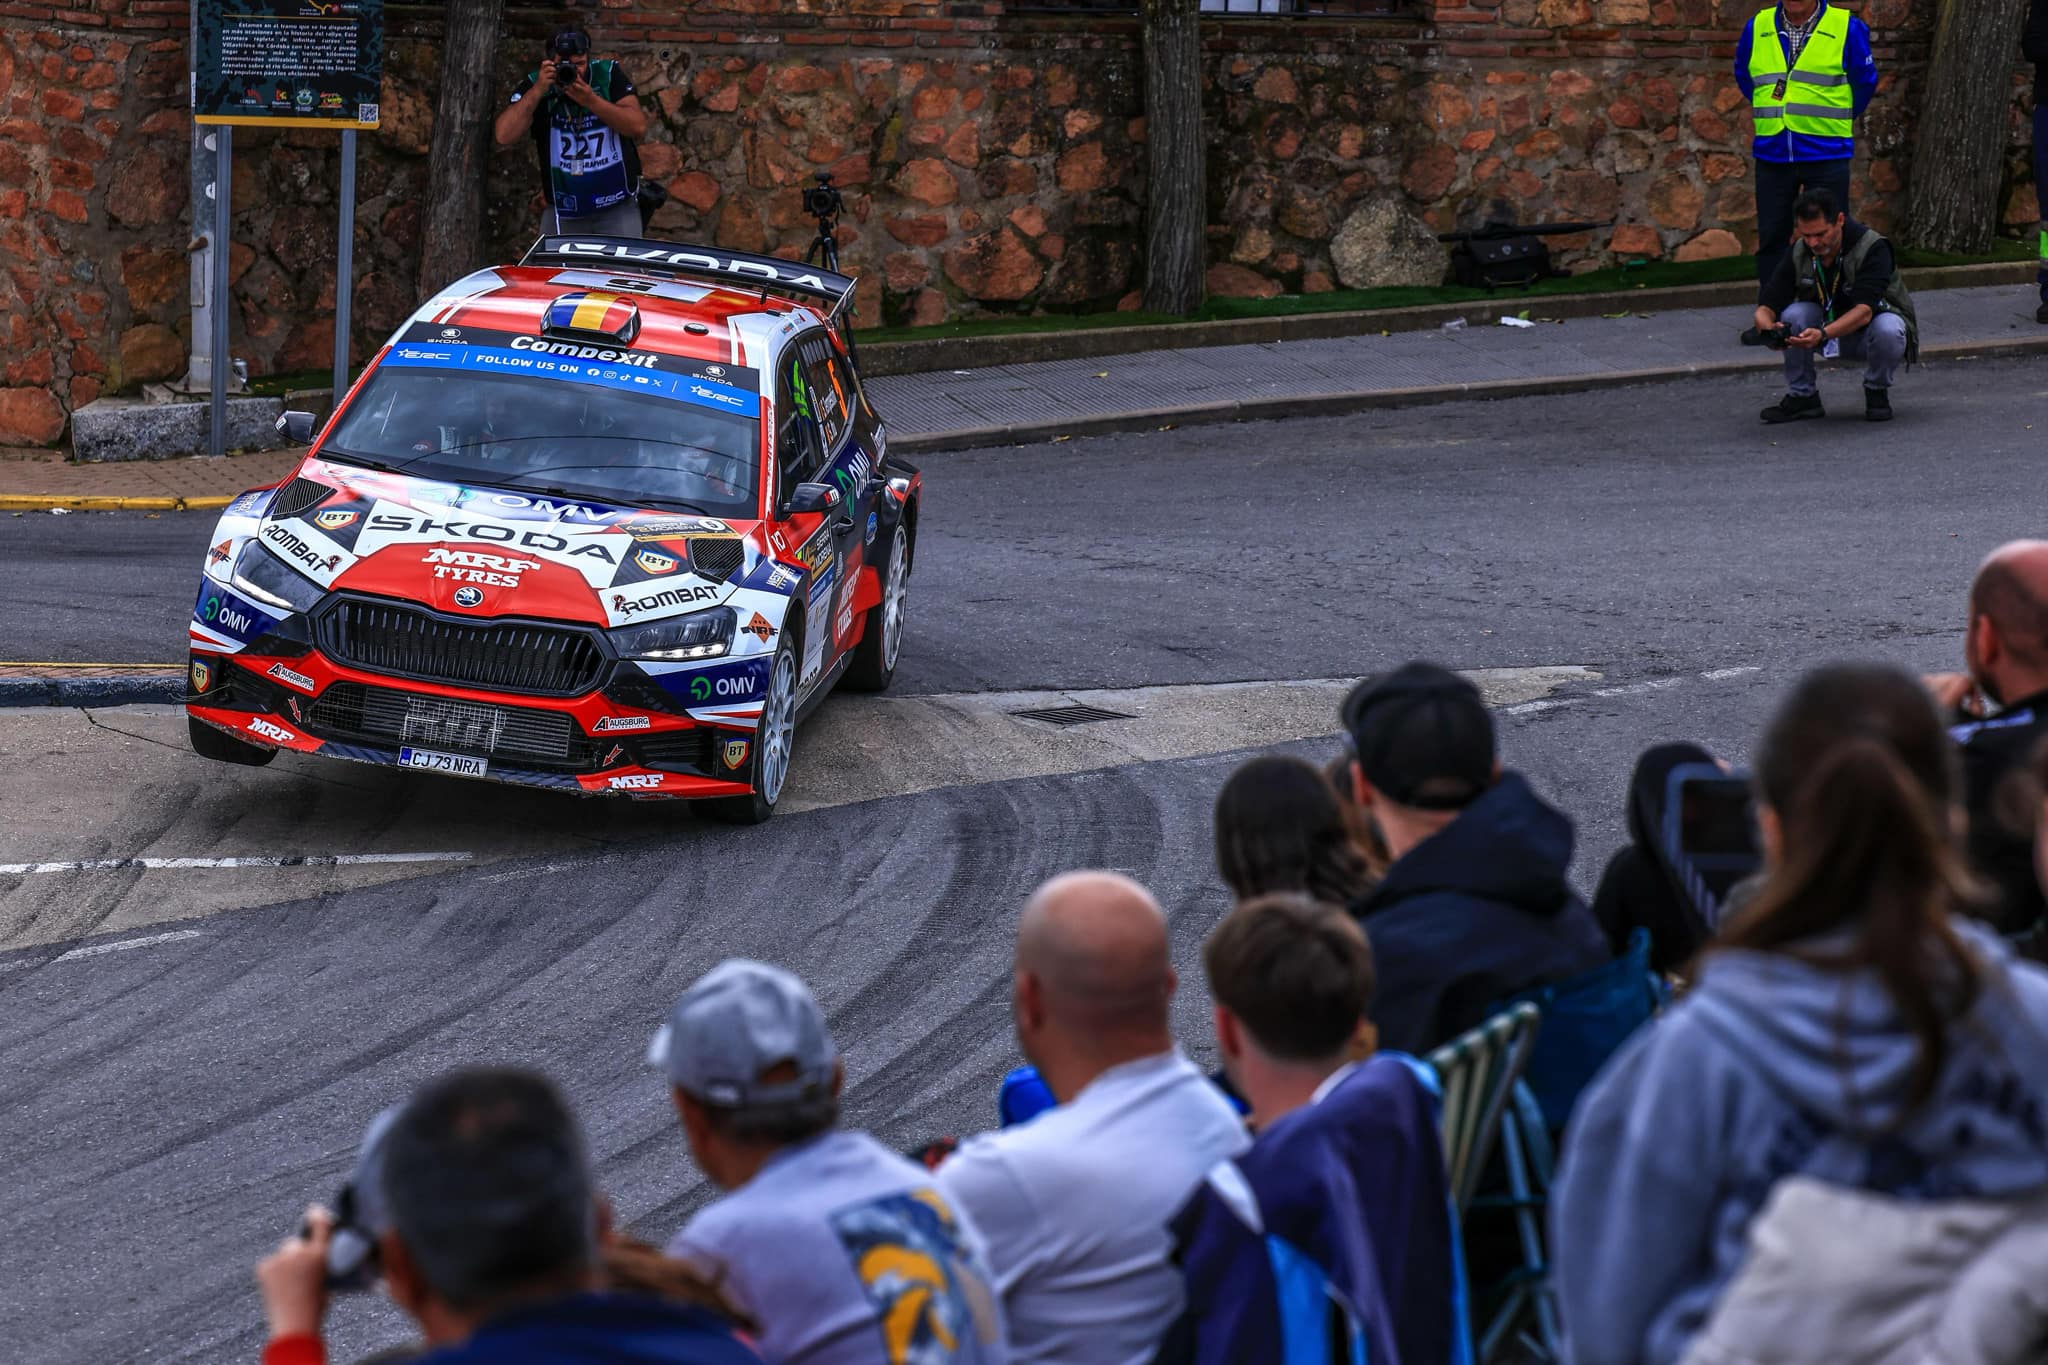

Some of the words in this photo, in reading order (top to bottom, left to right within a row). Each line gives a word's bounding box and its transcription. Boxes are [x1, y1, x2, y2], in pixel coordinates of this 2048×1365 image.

[560, 132, 605, 160] 227
[402, 349, 452, 360] ERC
[476, 354, 533, 367] FOLLOW
[536, 361, 555, 371] US
[559, 364, 580, 374] ON
[692, 373, 734, 388] SKODA
[697, 388, 745, 407] ERC
[325, 513, 351, 521] BT
[492, 495, 619, 521] OMV
[262, 525, 330, 572] ROMBAT
[367, 515, 616, 565] SKODA
[209, 547, 232, 563] NRF
[421, 548, 541, 574] MRF
[644, 555, 671, 567] BT
[434, 565, 520, 588] TYRES
[621, 586, 720, 615] ROMBAT
[219, 613, 252, 634] OMV
[741, 626, 778, 636] NRF
[194, 666, 206, 680] BT
[281, 669, 313, 688] AUGSBURG
[716, 676, 756, 696] OMV
[247, 717, 295, 742] MRF
[610, 717, 649, 727] AUGSBURG
[729, 746, 744, 757] BT
[412, 752, 431, 767] CJ
[435, 756, 451, 770] 73
[453, 758, 481, 775] NRA
[608, 774, 664, 789] MRF
